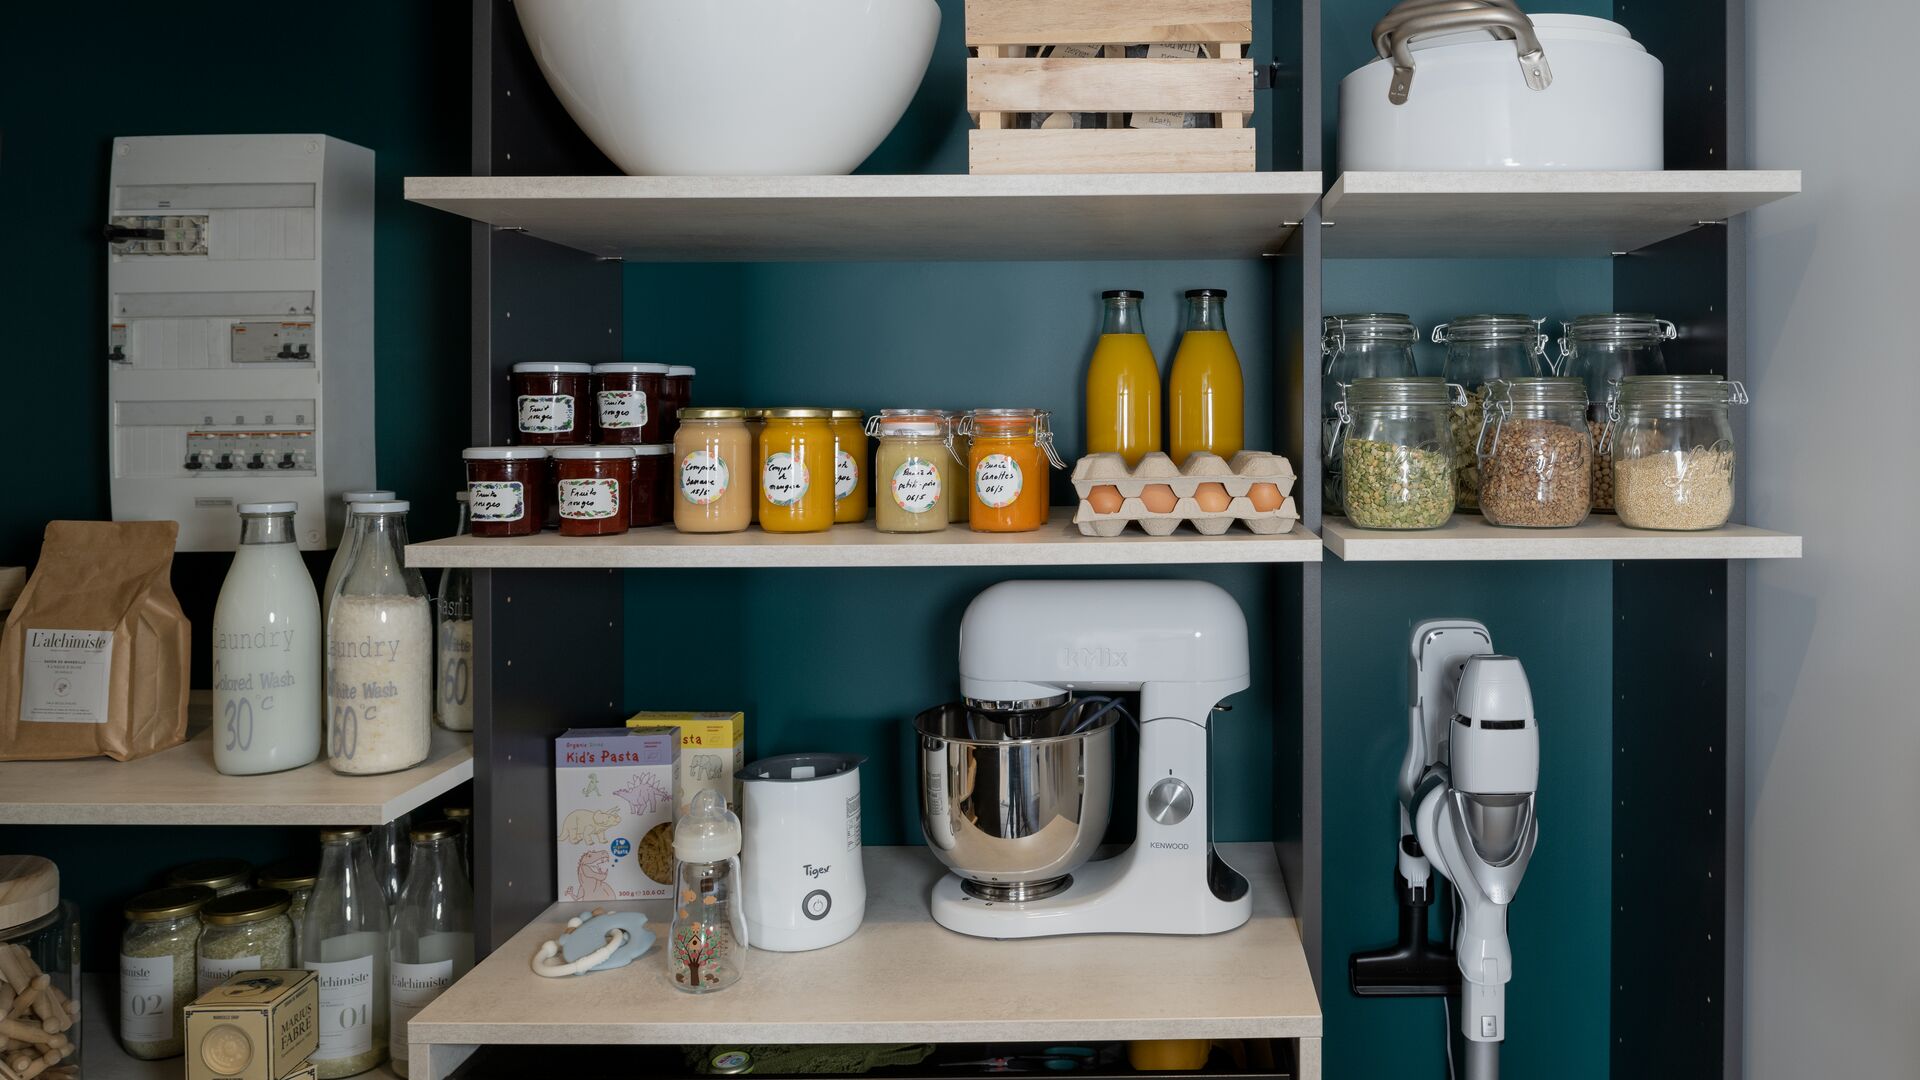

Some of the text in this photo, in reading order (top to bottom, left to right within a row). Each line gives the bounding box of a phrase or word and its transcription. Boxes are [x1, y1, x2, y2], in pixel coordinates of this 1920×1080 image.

[32, 632, 107, 650] L'alchimiste
[260, 670, 296, 690] Wash
[362, 680, 398, 700] Wash
[444, 657, 469, 706] 60
[225, 697, 253, 752] 30
[332, 704, 358, 760] 60
[682, 733, 703, 746] sta
[567, 749, 640, 764] Kid's Pasta
[1150, 842, 1190, 851] KENWOOD
[131, 994, 164, 1017] 02
[339, 1003, 367, 1029] 01
[280, 1003, 312, 1036] MARIUS
[280, 1016, 312, 1051] FABRE
